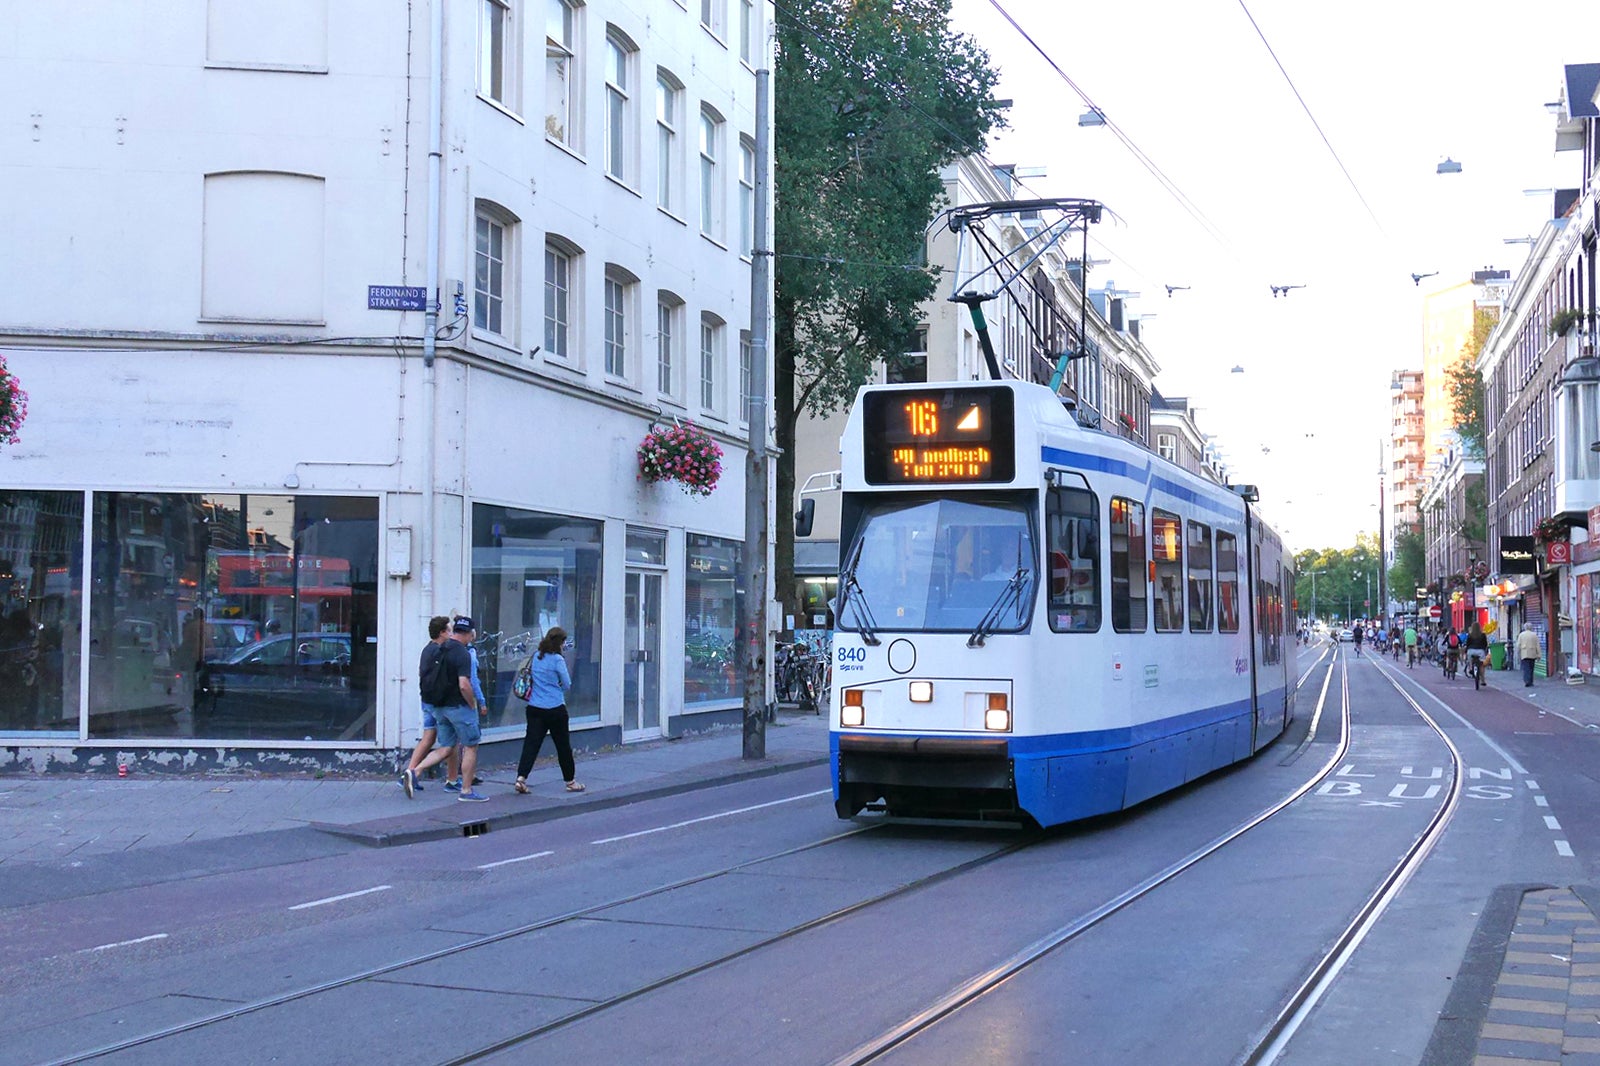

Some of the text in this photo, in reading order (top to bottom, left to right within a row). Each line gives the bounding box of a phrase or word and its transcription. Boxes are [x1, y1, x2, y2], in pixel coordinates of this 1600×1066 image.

[371, 287, 419, 298] FERDINAND
[370, 297, 400, 307] STRAAT
[904, 401, 937, 436] 16
[838, 647, 866, 662] 840
[1314, 780, 1514, 800] BUS
